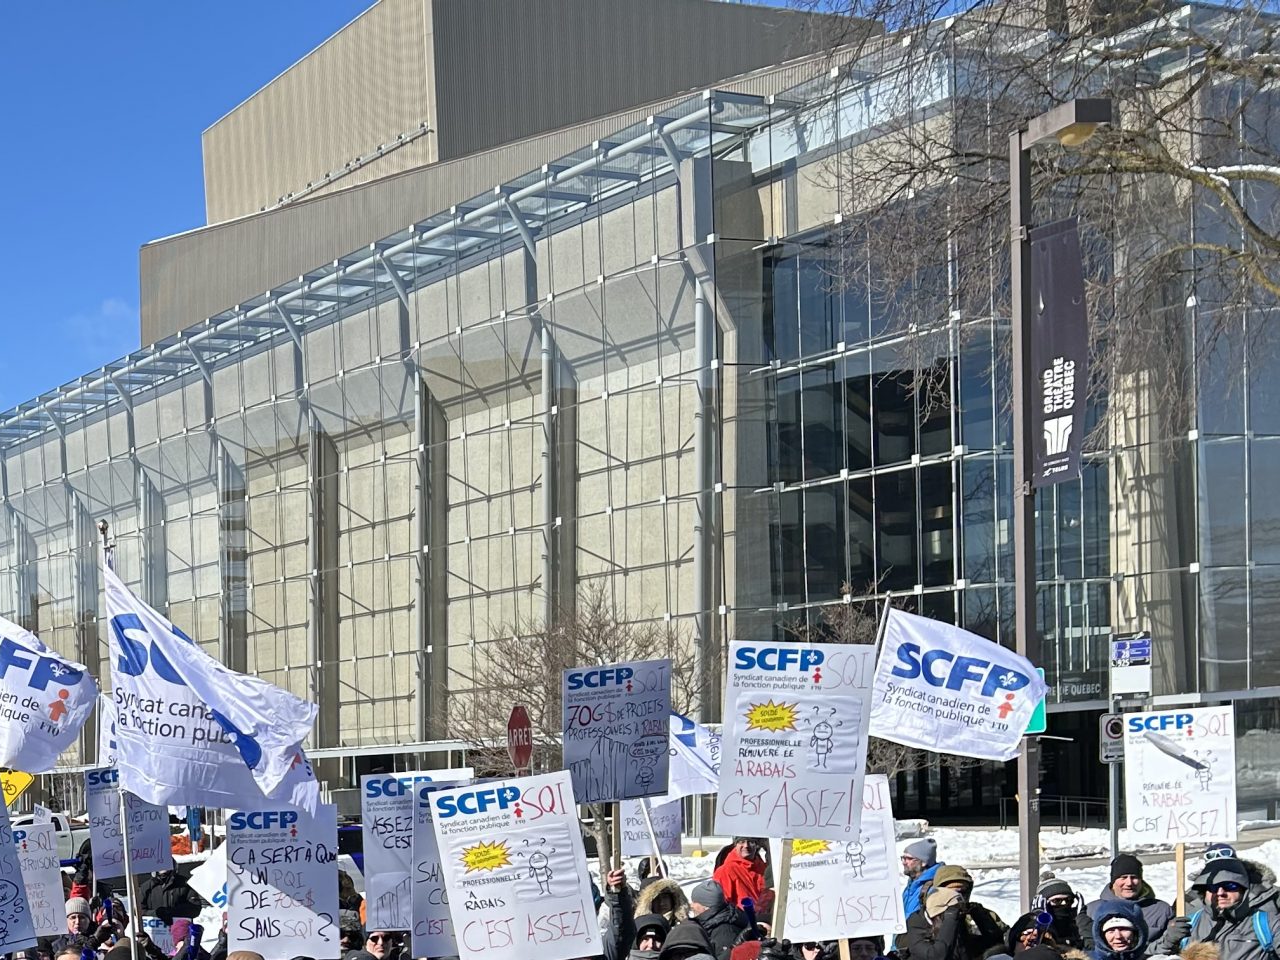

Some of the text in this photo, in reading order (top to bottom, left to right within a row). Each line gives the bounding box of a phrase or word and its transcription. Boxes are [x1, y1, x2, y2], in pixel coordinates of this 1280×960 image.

[1044, 369, 1054, 414] GRAND
[1121, 650, 1130, 659] 28
[1125, 641, 1130, 649] 3
[735, 647, 824, 672] SCFP
[824, 651, 870, 689] SQI
[891, 641, 1030, 698] SCFP
[567, 667, 634, 690] SCFP
[633, 666, 668, 695] SQI
[733, 673, 797, 683] Syndicat canadien
[741, 681, 806, 691] fonction publique
[21, 696, 39, 711] de
[625, 699, 664, 719] PROJETS
[886, 682, 991, 716] Syndicat canadien de
[894, 695, 985, 727] fonction publique
[131, 712, 185, 739] foction
[1128, 713, 1194, 733] SCFP
[1197, 712, 1231, 738] SQI
[747, 759, 797, 779] RABAIS
[437, 785, 520, 819] SCFP
[521, 782, 569, 821] SQI
[722, 778, 855, 833] C'EST ASSEZ!
[1151, 791, 1193, 808] RABAIS
[230, 810, 298, 830] SCFP
[371, 815, 413, 838] ASSEZ
[439, 815, 501, 829] Syndicat canadien
[448, 820, 510, 835] fonction publique
[1132, 815, 1162, 833] C'EST
[28, 830, 55, 853] SQI
[231, 846, 255, 874] ÇA
[260, 845, 305, 866] SERT
[251, 866, 306, 889] UN PQI
[241, 889, 271, 910] DE
[272, 891, 316, 910] 70G$
[464, 898, 506, 911] RABAIS
[787, 888, 903, 931] C'EST ASSEZ!
[236, 916, 281, 941] SANS
[283, 918, 314, 940] SQI
[415, 918, 449, 937] C'EST
[462, 899, 592, 952] C'EST ASSEZ!
